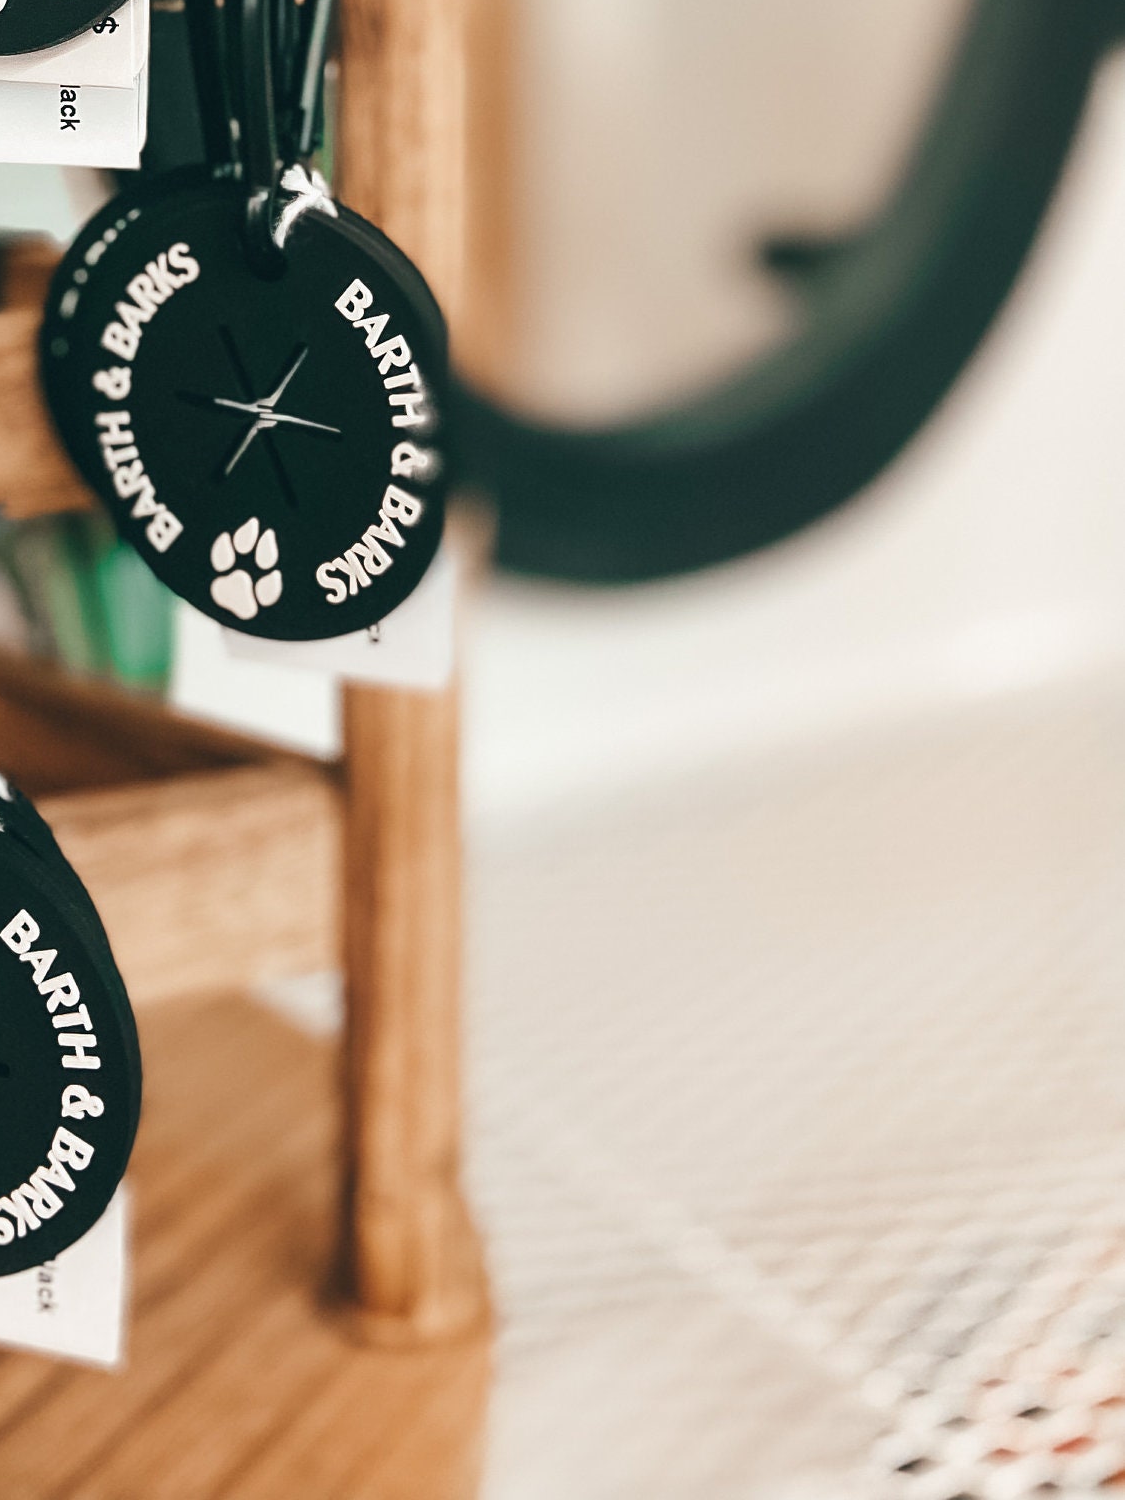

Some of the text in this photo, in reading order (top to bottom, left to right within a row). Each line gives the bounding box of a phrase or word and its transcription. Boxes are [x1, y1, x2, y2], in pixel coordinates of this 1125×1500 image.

[60, 84, 81, 131] lack
[101, 242, 199, 360] BARKS
[94, 367, 131, 399] &
[316, 278, 430, 603] BARTH & BARKS
[96, 412, 183, 552] BARTH
[0, 908, 101, 1069] BARTH
[62, 1085, 104, 1119] &
